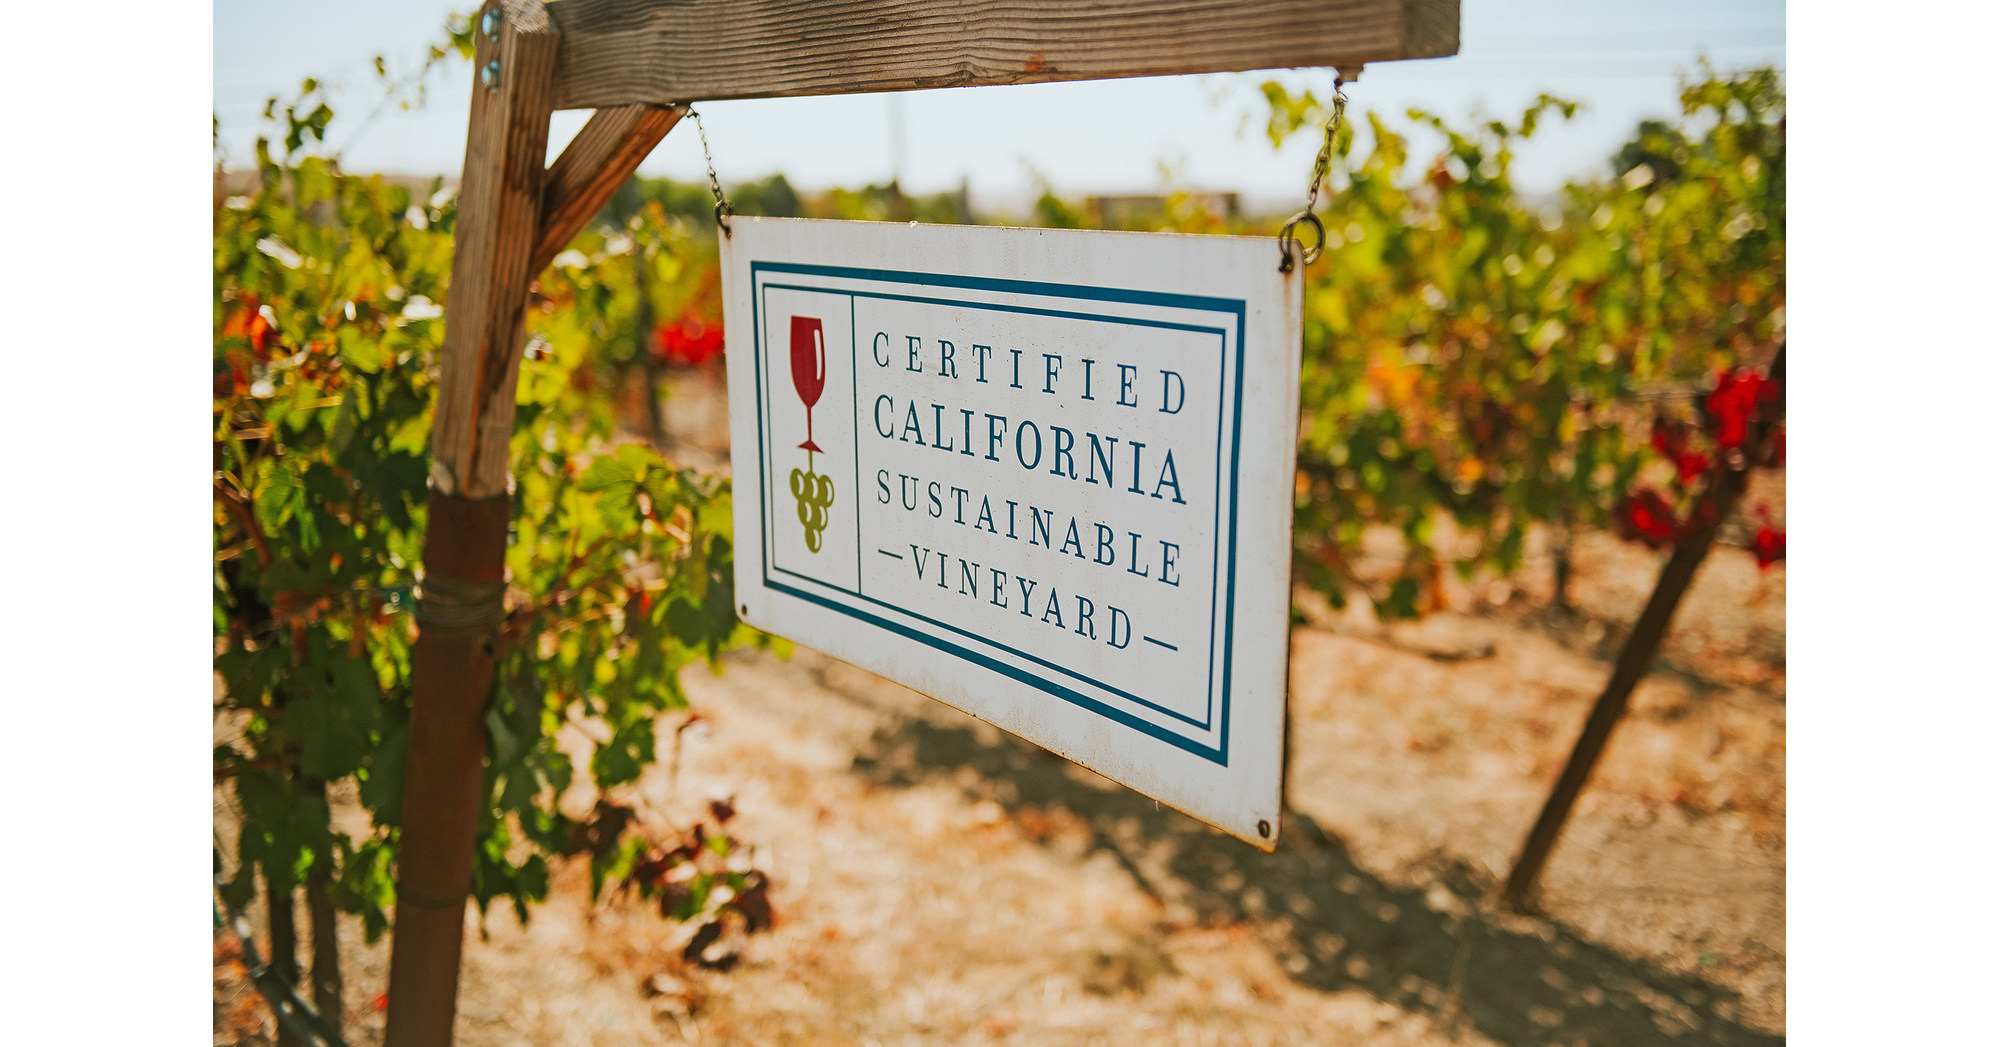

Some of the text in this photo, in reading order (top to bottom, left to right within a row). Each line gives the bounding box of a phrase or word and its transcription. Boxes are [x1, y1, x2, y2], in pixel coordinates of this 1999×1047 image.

[872, 331, 1186, 415] CERTIFIED
[874, 394, 1187, 506] CALIFORNIA
[877, 469, 1181, 588] SUSTAINABLE
[909, 543, 1132, 650] VINEYARD
